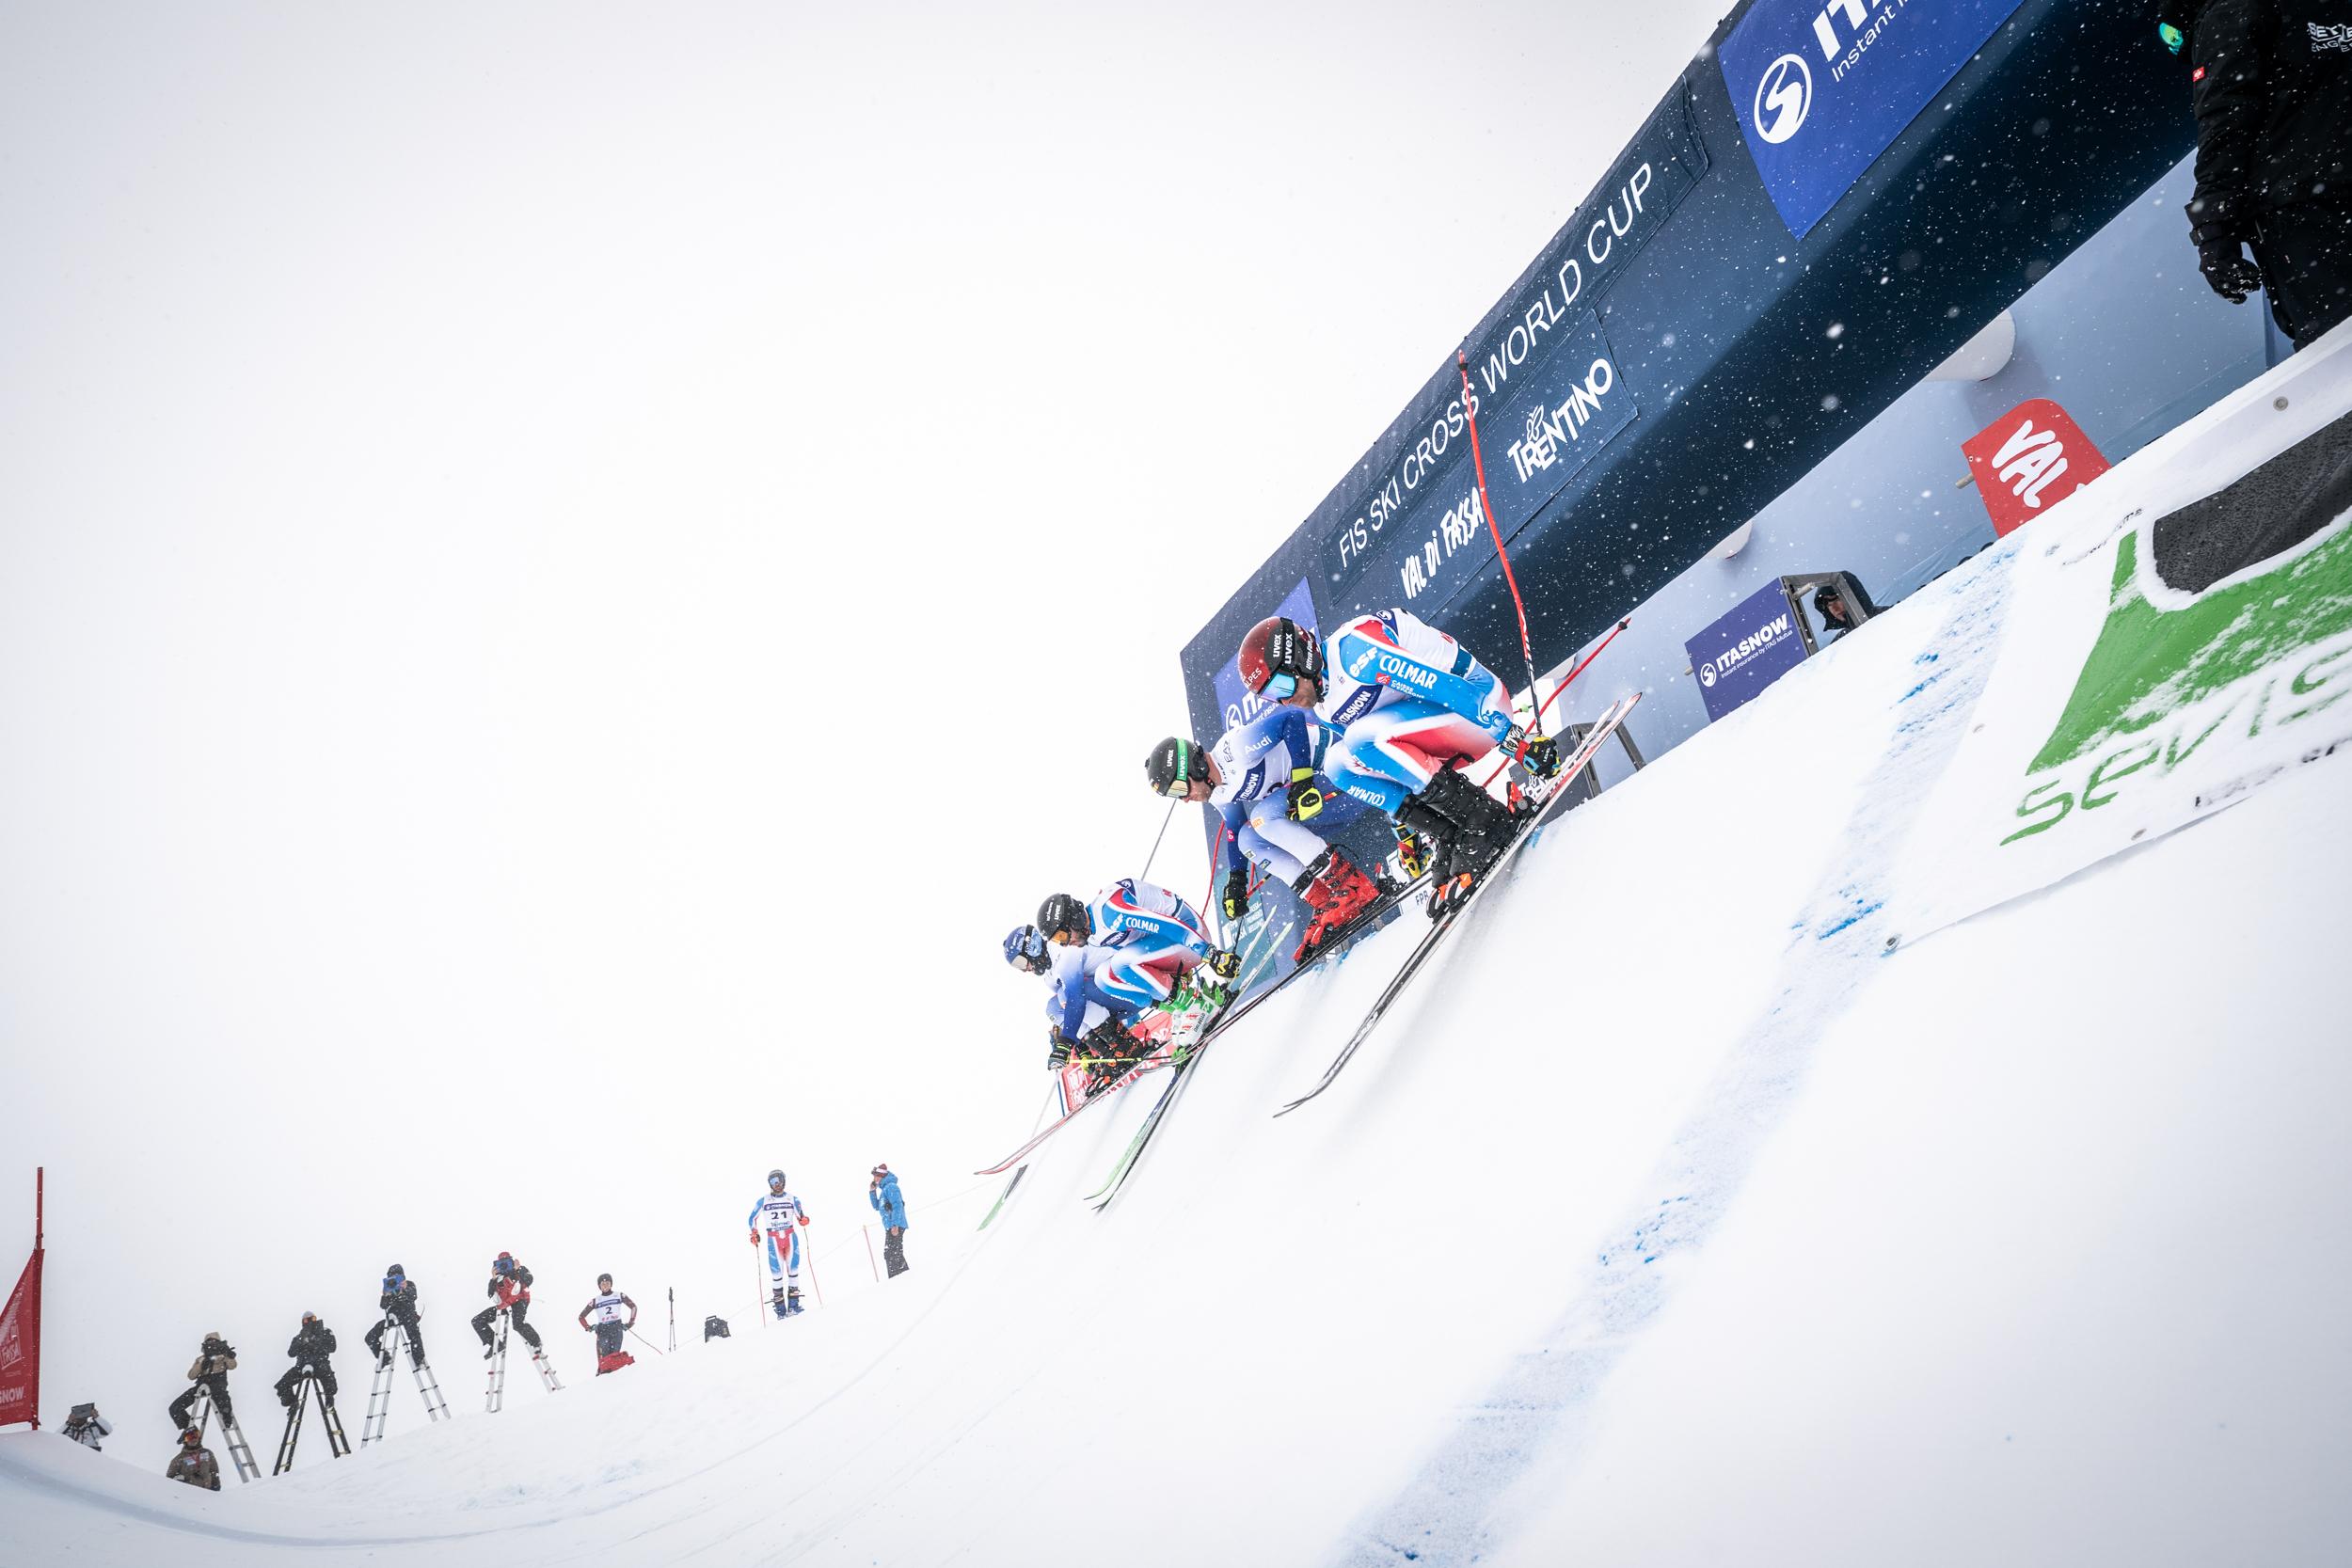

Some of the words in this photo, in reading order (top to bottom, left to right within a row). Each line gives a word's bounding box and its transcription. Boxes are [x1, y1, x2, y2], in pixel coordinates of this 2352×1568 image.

[1831, 5, 1897, 83] Instant
[1339, 517, 1367, 568] FIS
[1370, 475, 1401, 531] SKI
[1403, 382, 1480, 490] CROSS
[1480, 259, 1582, 394] WORLD
[1587, 162, 1652, 264] CUP
[1506, 357, 1613, 483] TRENTINO
[1991, 419, 2069, 509] VAL
[1400, 554, 1428, 600] VAL
[1439, 486, 1485, 558] FASSA
[1272, 633, 1282, 658] uvex
[1284, 632, 1293, 665] uvex
[1715, 613, 1788, 673] ITASNOW
[1758, 646, 1766, 656] by
[1764, 639, 1777, 651] ITAS
[1378, 654, 1438, 689] COLMAR
[1166, 749, 1174, 768] uvex
[1244, 735, 1273, 754] Audi
[1241, 772, 1260, 800] ITASNOW
[1346, 784, 1386, 807] COLMAR
[1125, 917, 1160, 934] COLMAR
[771, 1211, 787, 1220] 21
[605, 1306, 613, 1315] 2
